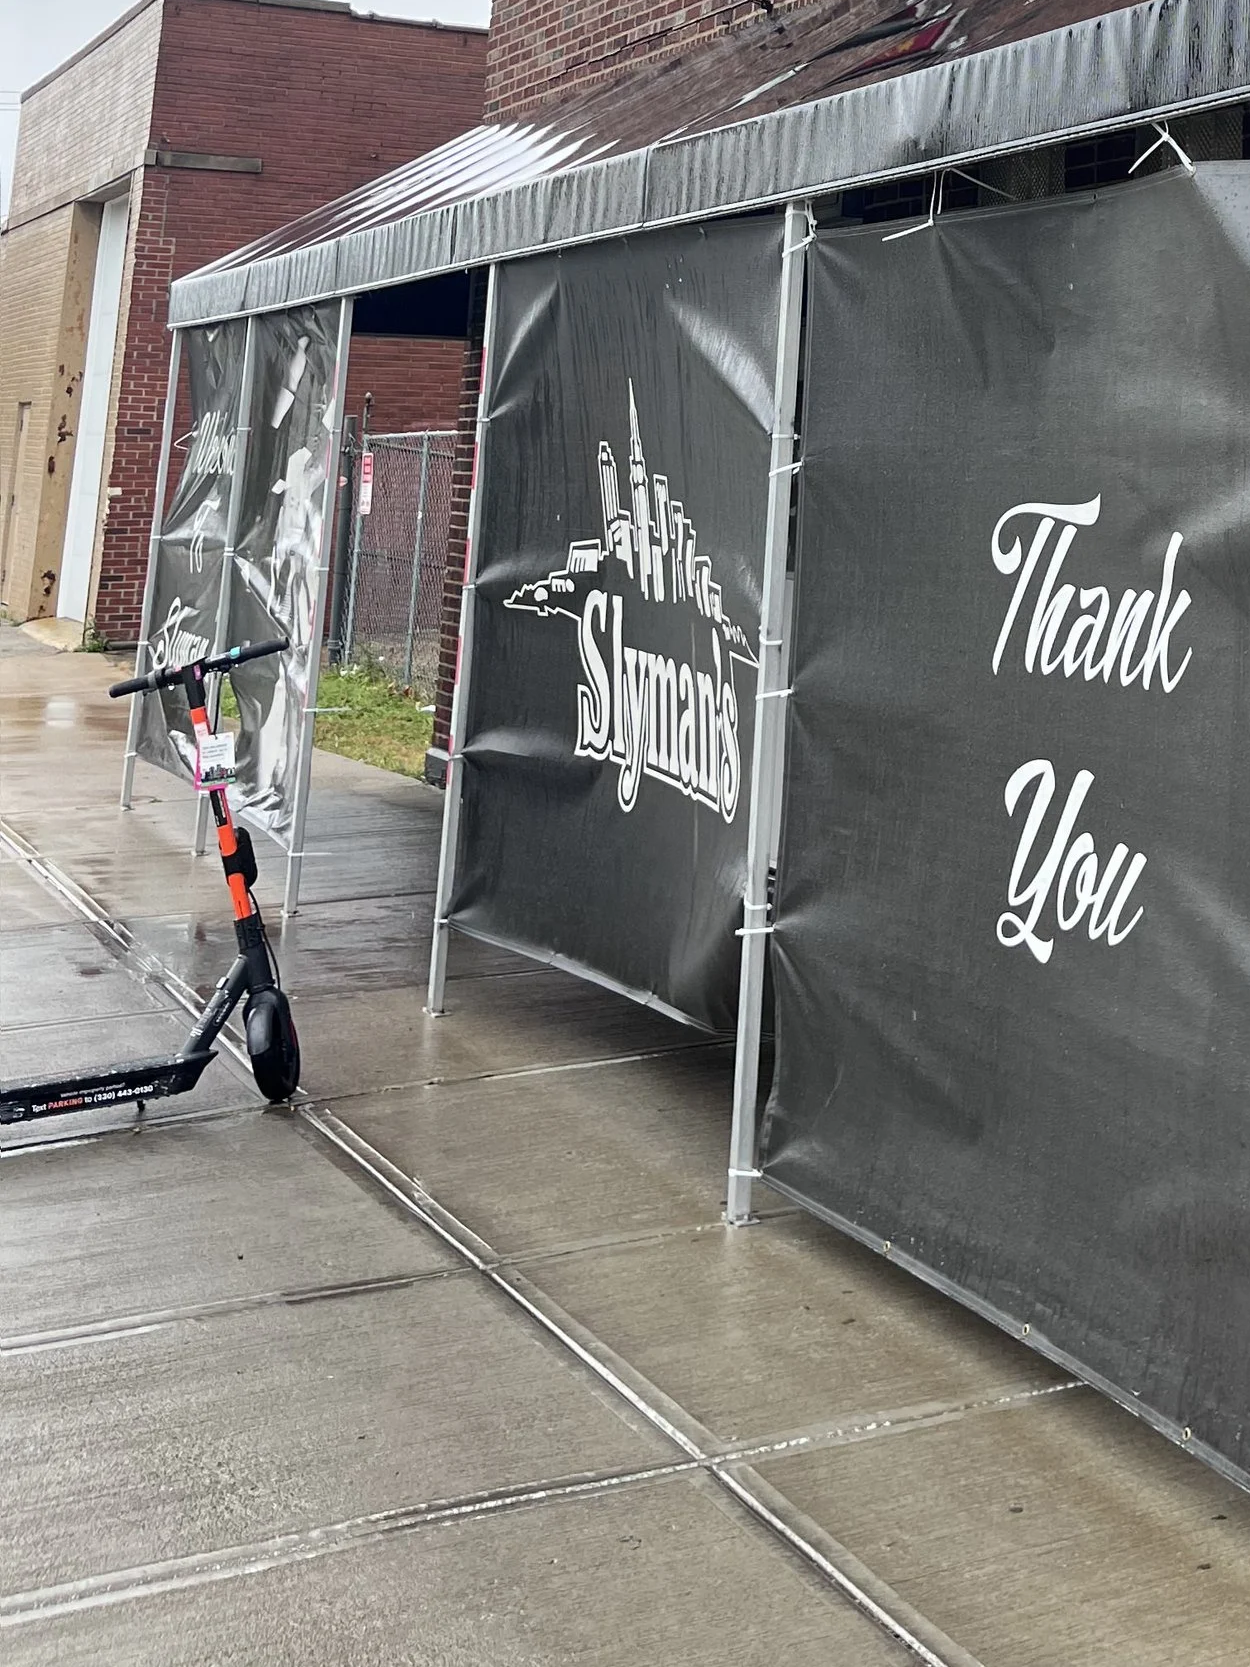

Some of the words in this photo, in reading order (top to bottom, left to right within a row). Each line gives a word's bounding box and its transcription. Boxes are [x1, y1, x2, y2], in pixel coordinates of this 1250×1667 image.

[990, 493, 1195, 695] Thank
[574, 589, 743, 824] Slyman's
[996, 756, 1149, 965] You
[31, 1103, 48, 1113] Text
[48, 1097, 83, 1110] PARKING
[84, 1095, 92, 1104] to
